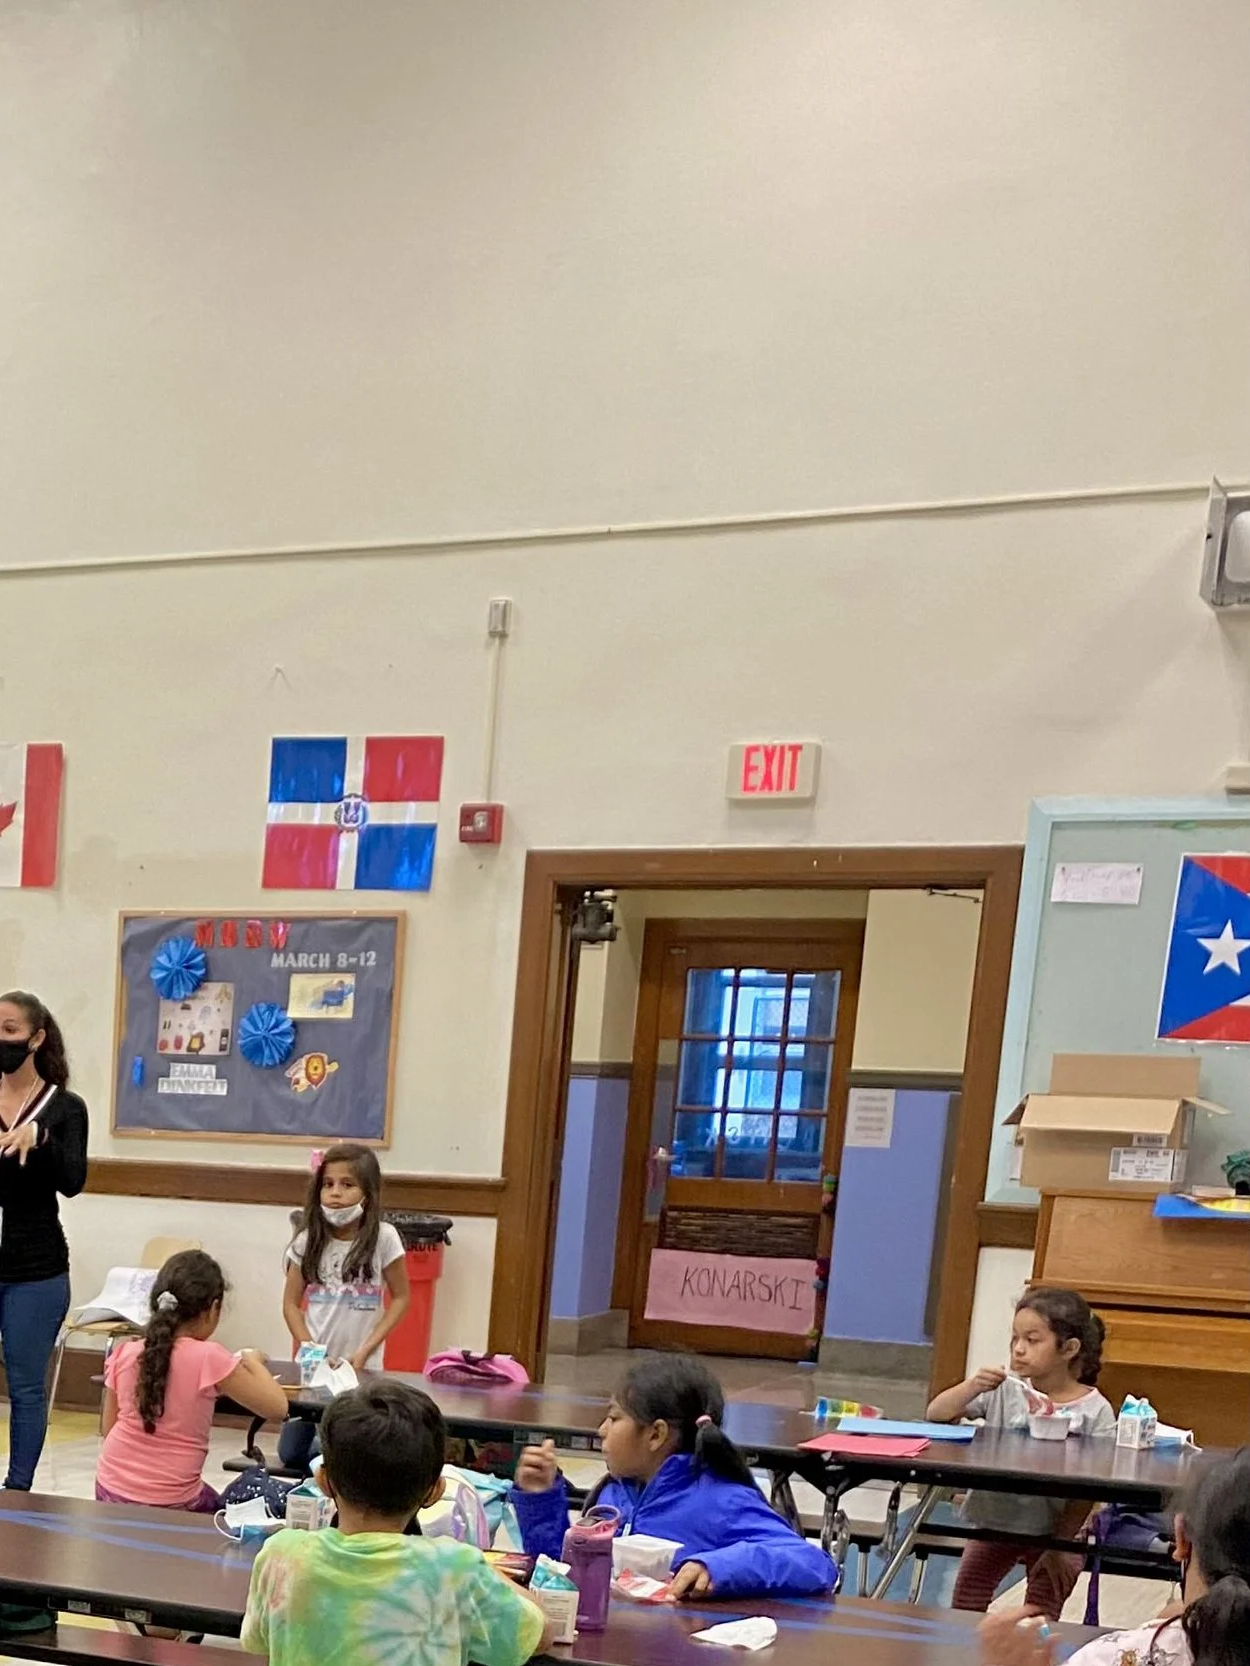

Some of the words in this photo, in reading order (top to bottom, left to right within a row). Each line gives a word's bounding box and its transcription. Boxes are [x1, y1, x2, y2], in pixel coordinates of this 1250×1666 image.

[742, 743, 803, 792] EXIT
[270, 952, 330, 968] MARCH
[336, 951, 377, 968] 8-12
[171, 1063, 216, 1079] EMMA
[680, 1265, 806, 1310] KONARSKI
